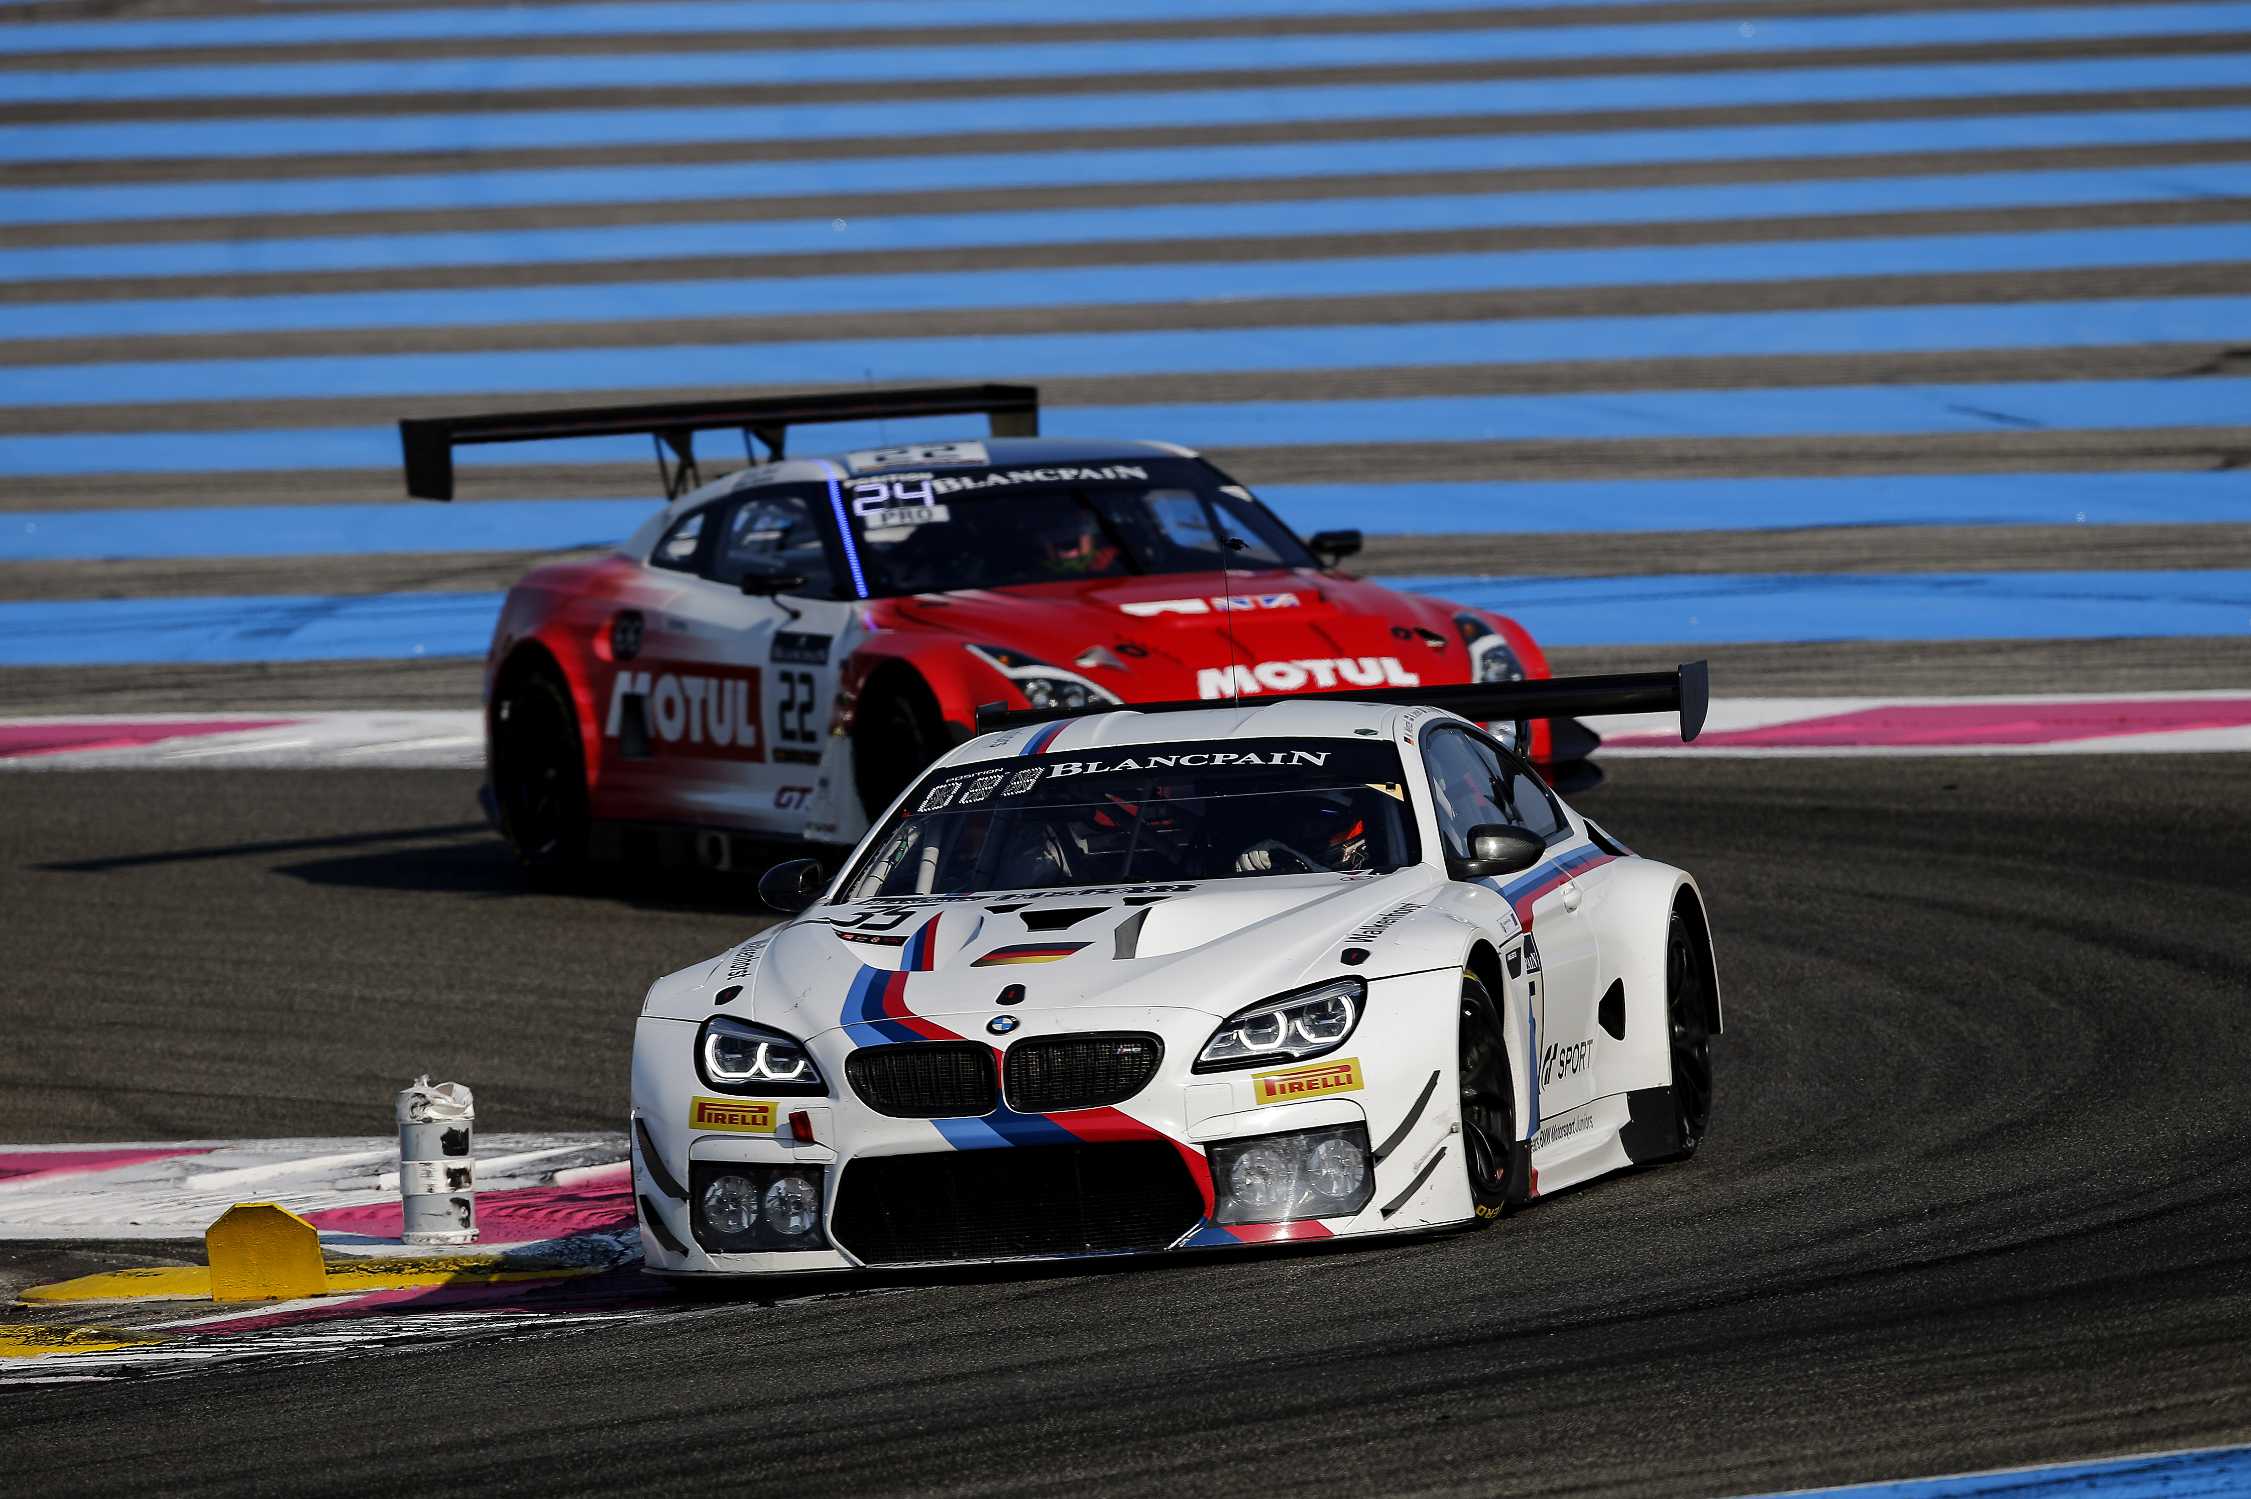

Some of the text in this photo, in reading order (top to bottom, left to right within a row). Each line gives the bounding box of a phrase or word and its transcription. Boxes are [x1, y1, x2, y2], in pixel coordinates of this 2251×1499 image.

[931, 465, 1149, 493] BLANCPAIN
[853, 480, 934, 516] 24
[881, 507, 933, 522] PRO
[1197, 656, 1420, 700] MOTUL
[779, 670, 817, 742] 22
[1045, 750, 1332, 779] BLANCPAIN
[1344, 902, 1427, 942] Walkenhorst
[1558, 1039, 1594, 1080] SPORT
[1264, 1064, 1353, 1097] PIRELLI
[697, 1102, 769, 1126] PIRELLI
